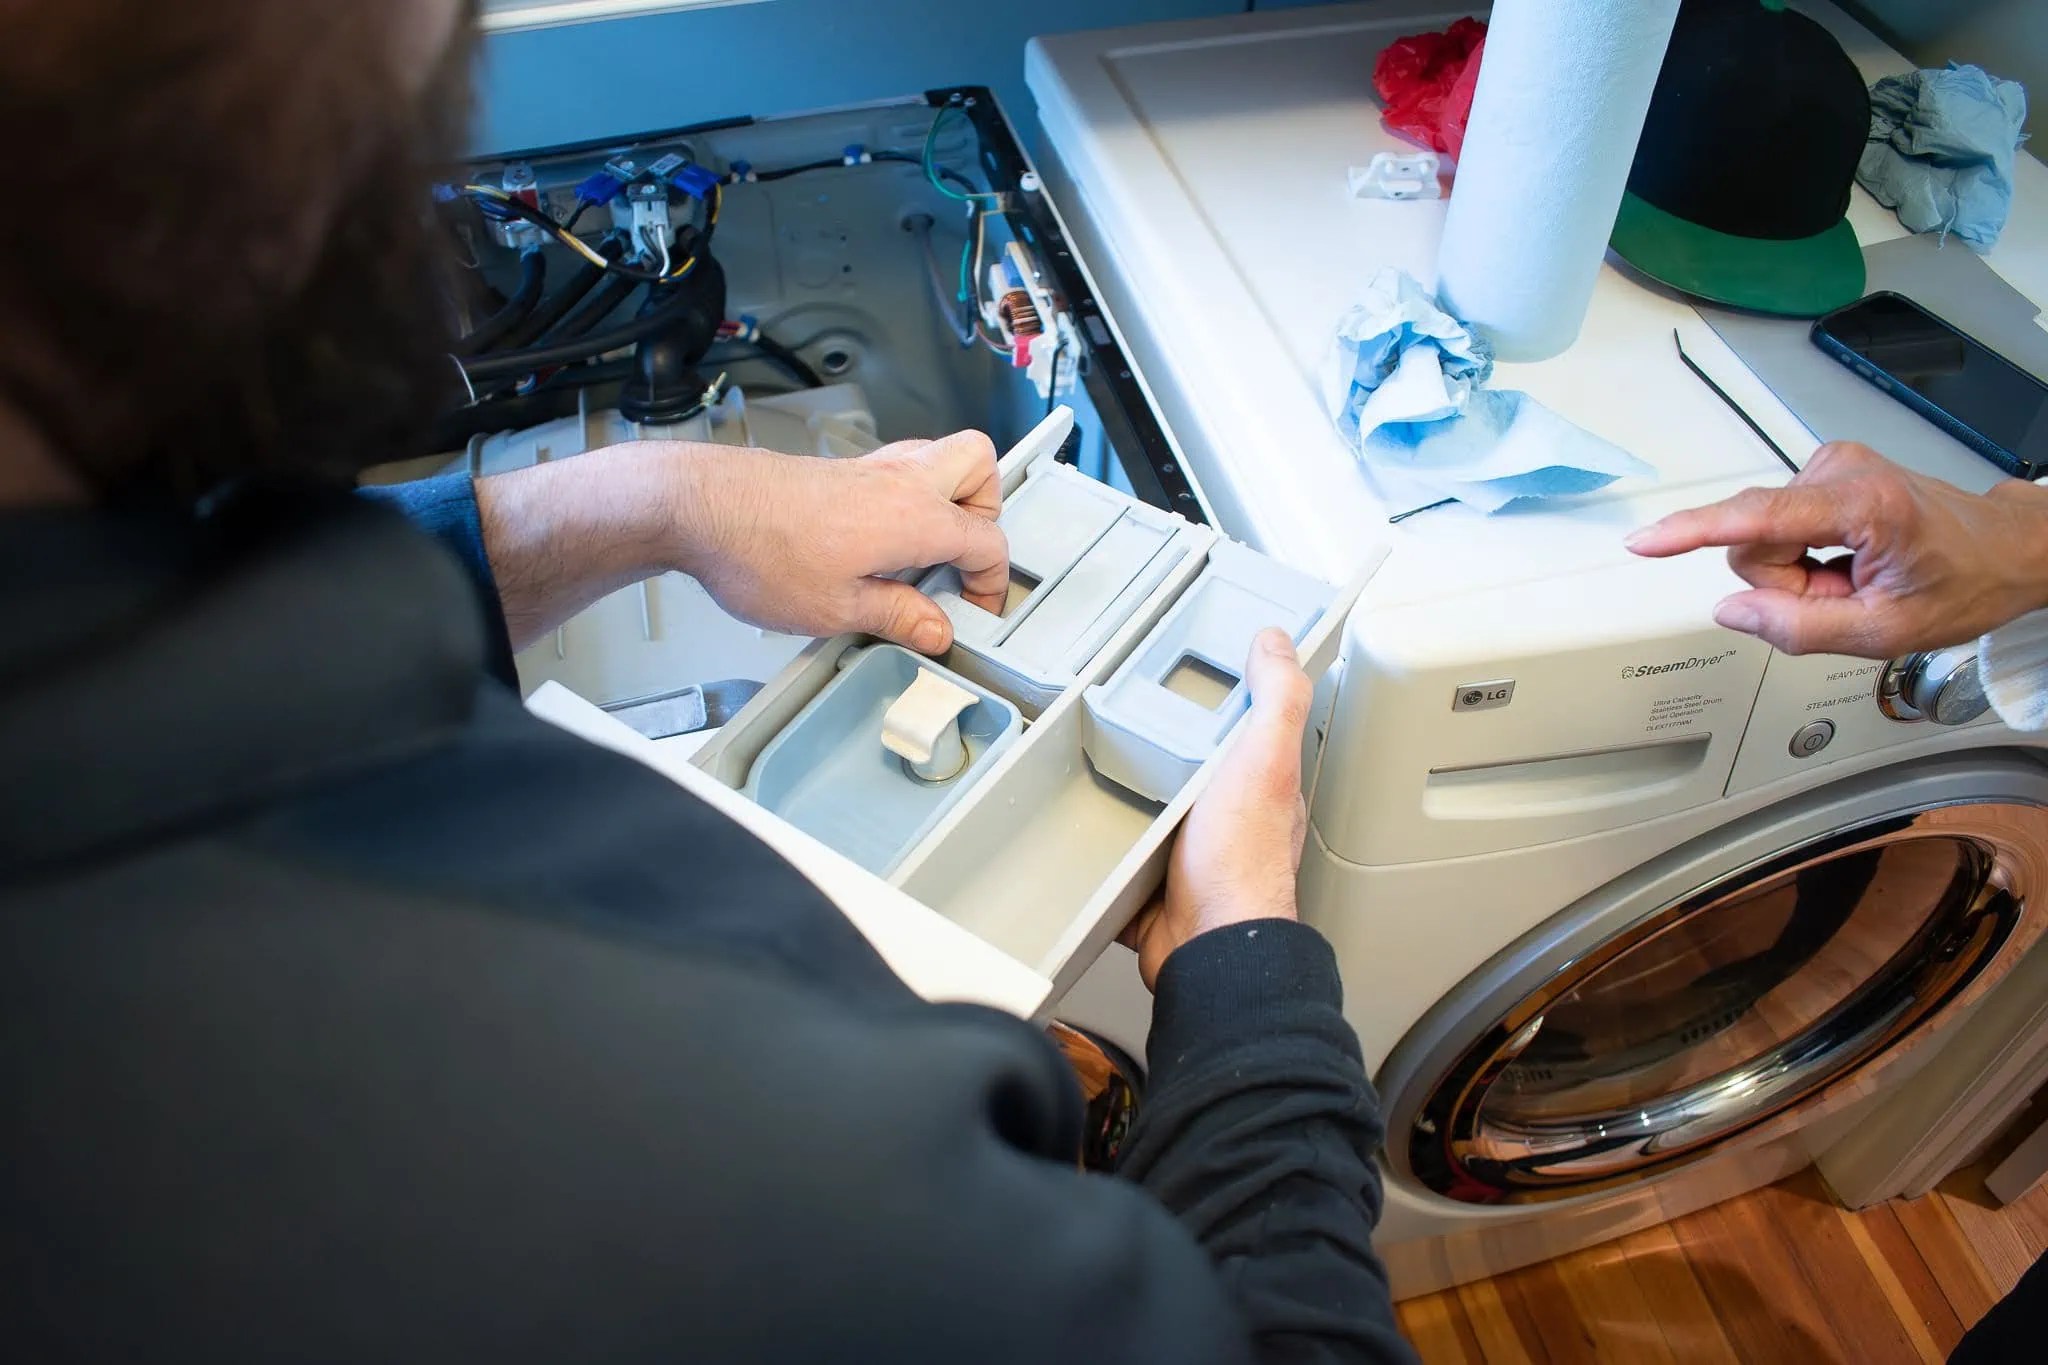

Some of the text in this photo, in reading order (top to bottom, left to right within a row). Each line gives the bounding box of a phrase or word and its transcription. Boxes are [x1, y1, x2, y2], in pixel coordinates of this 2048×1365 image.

[1826, 665, 1880, 681] HEAVY DUTY
[1487, 689, 1507, 701] LG
[1683, 700, 1702, 709] Steel
[1702, 698, 1722, 706] Drum
[1805, 700, 1837, 711] STEAM
